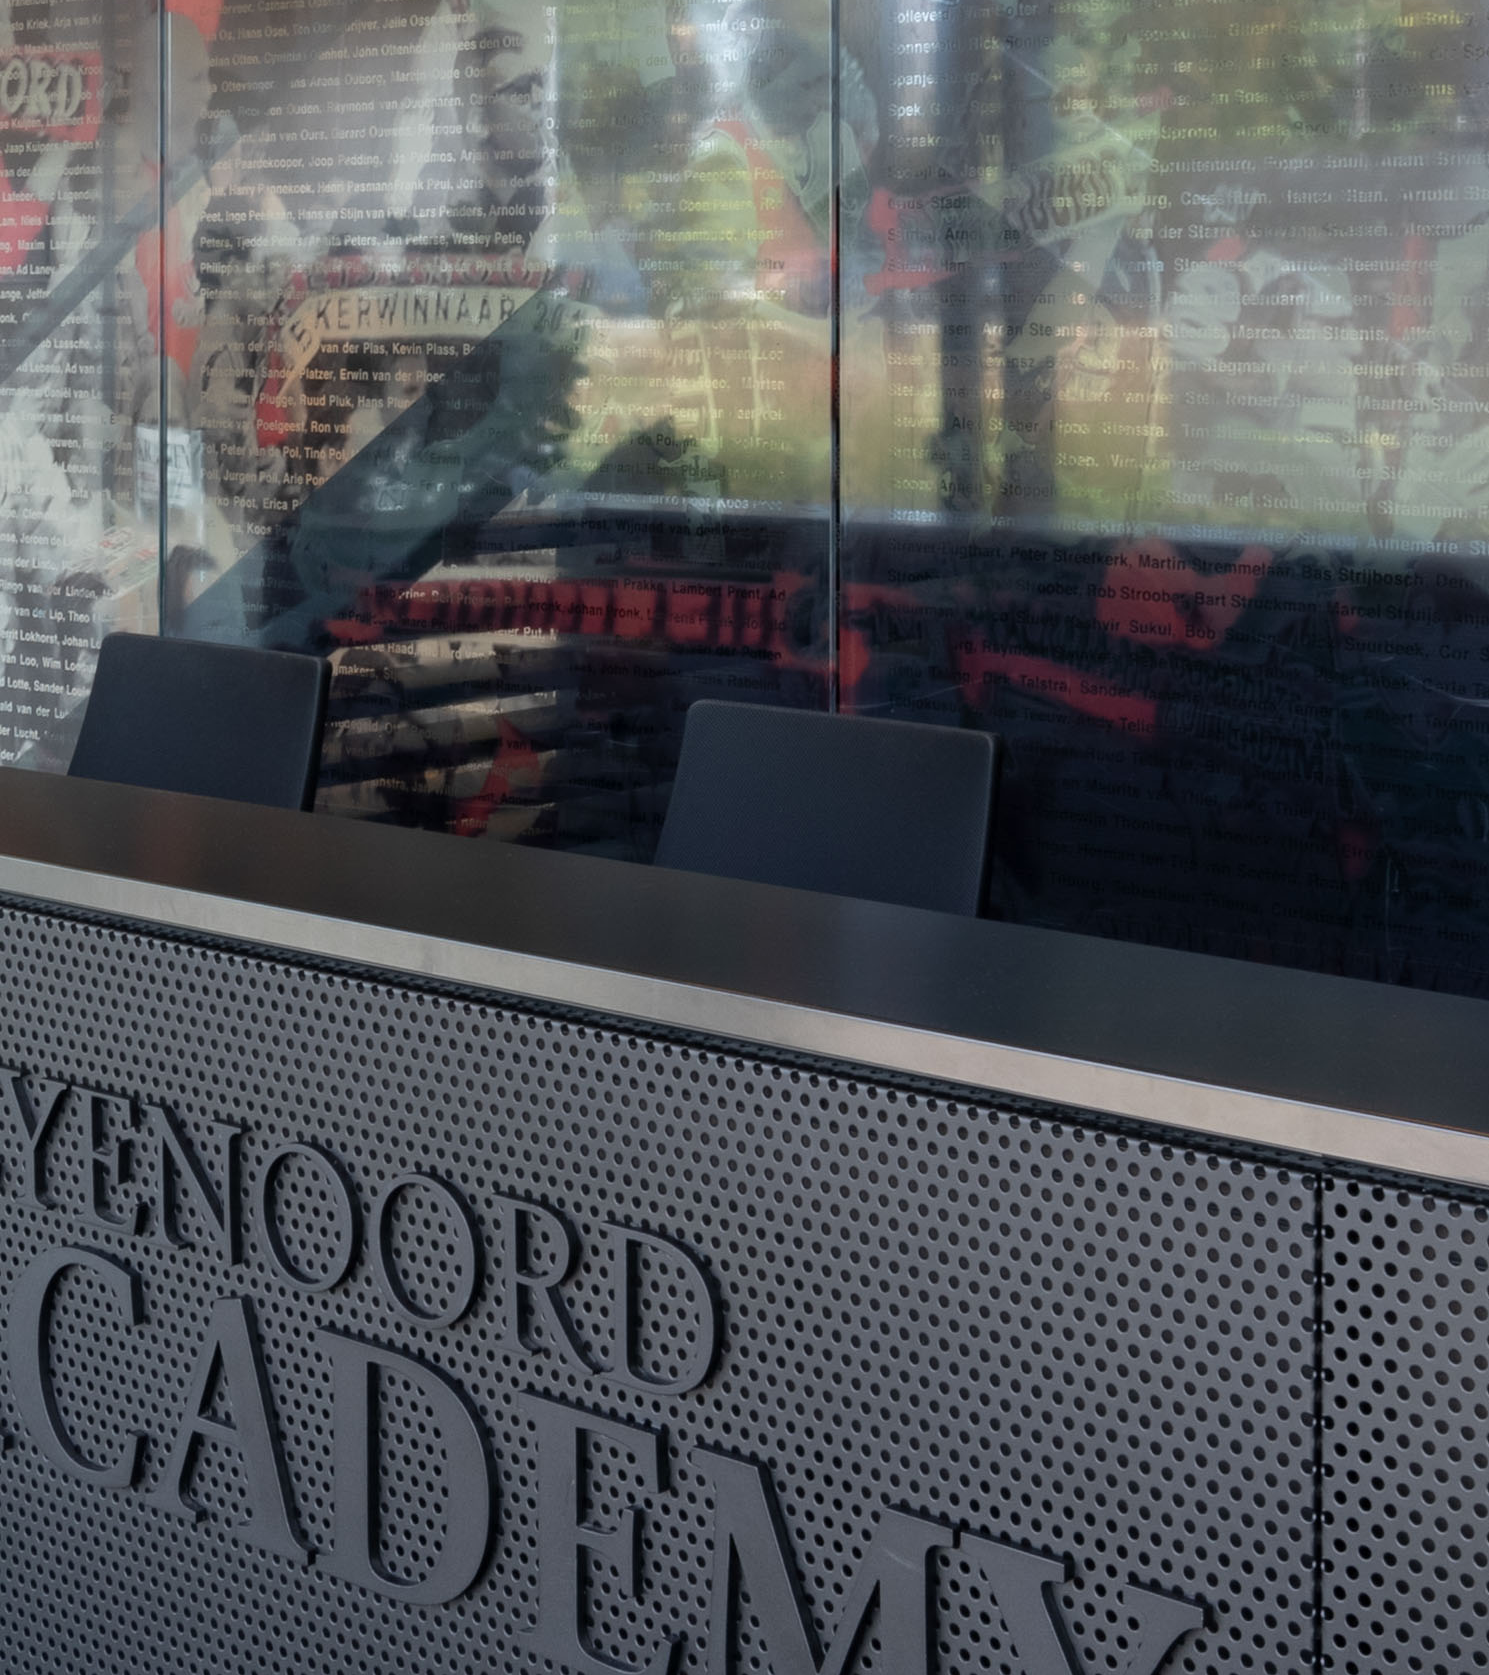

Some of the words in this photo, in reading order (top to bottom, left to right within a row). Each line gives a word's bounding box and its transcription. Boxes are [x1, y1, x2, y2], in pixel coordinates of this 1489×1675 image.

[392, 344, 422, 356] Kevin
[340, 369, 370, 381] Erwin
[299, 394, 326, 407] Ruud
[310, 420, 330, 433] Ron
